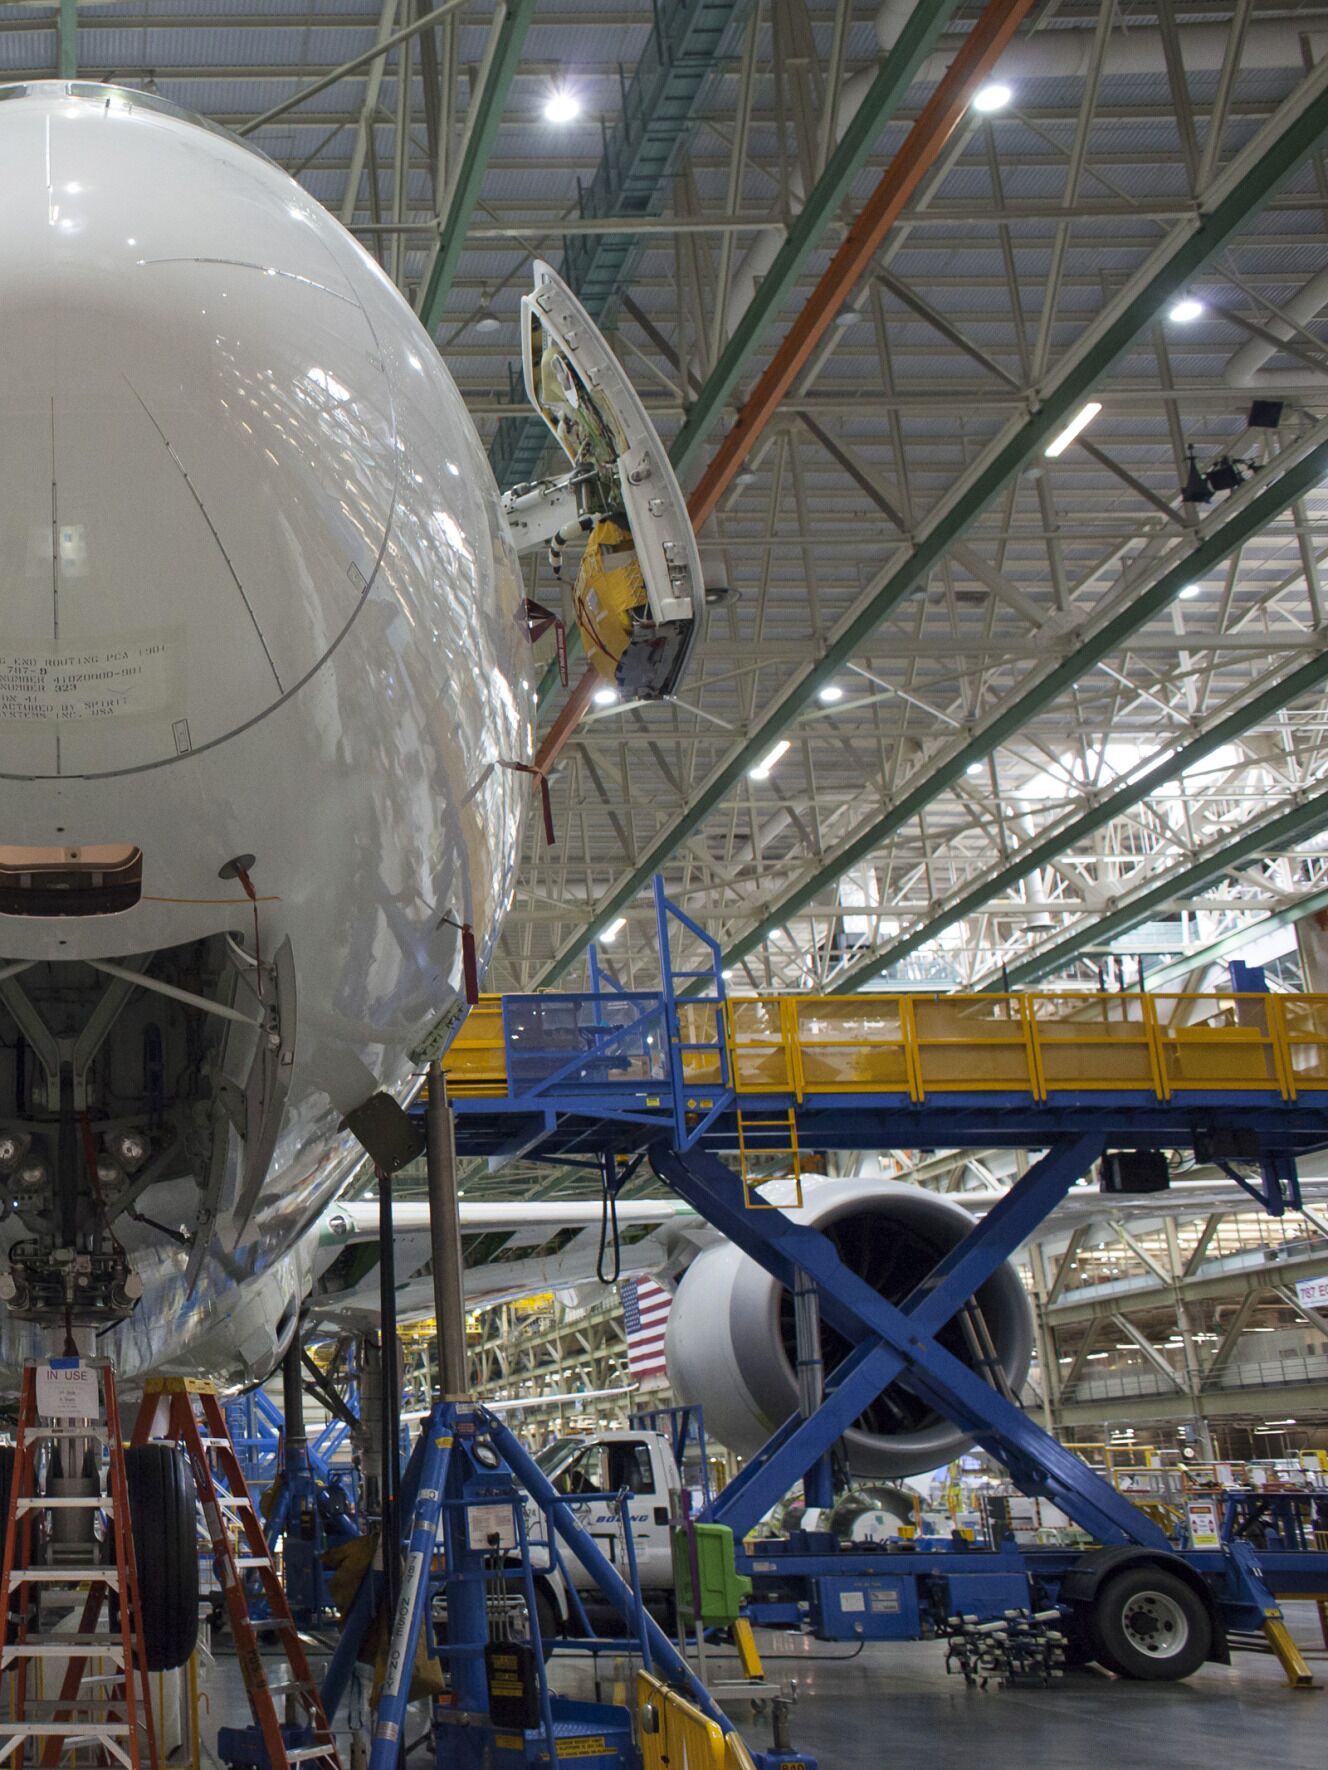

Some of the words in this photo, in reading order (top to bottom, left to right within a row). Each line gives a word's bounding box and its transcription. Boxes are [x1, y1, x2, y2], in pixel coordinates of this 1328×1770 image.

[14, 656, 36, 666] END
[7, 666, 47, 675] 787-9
[0, 674, 46, 684] NUMBER
[0, 683, 47, 692] NUMBER
[24, 695, 37, 703] 41
[61, 703, 74, 711] BY
[84, 696, 128, 710] SPIRIT
[91, 707, 114, 717] USA
[1300, 1286, 1316, 1299] 787
[46, 1370, 59, 1380] IN
[64, 1370, 89, 1381] USE
[595, 1514, 649, 1523] BOENG
[406, 1555, 418, 1583] 787
[396, 1596, 411, 1637] NOSE
[384, 1650, 402, 1692] ONLY
